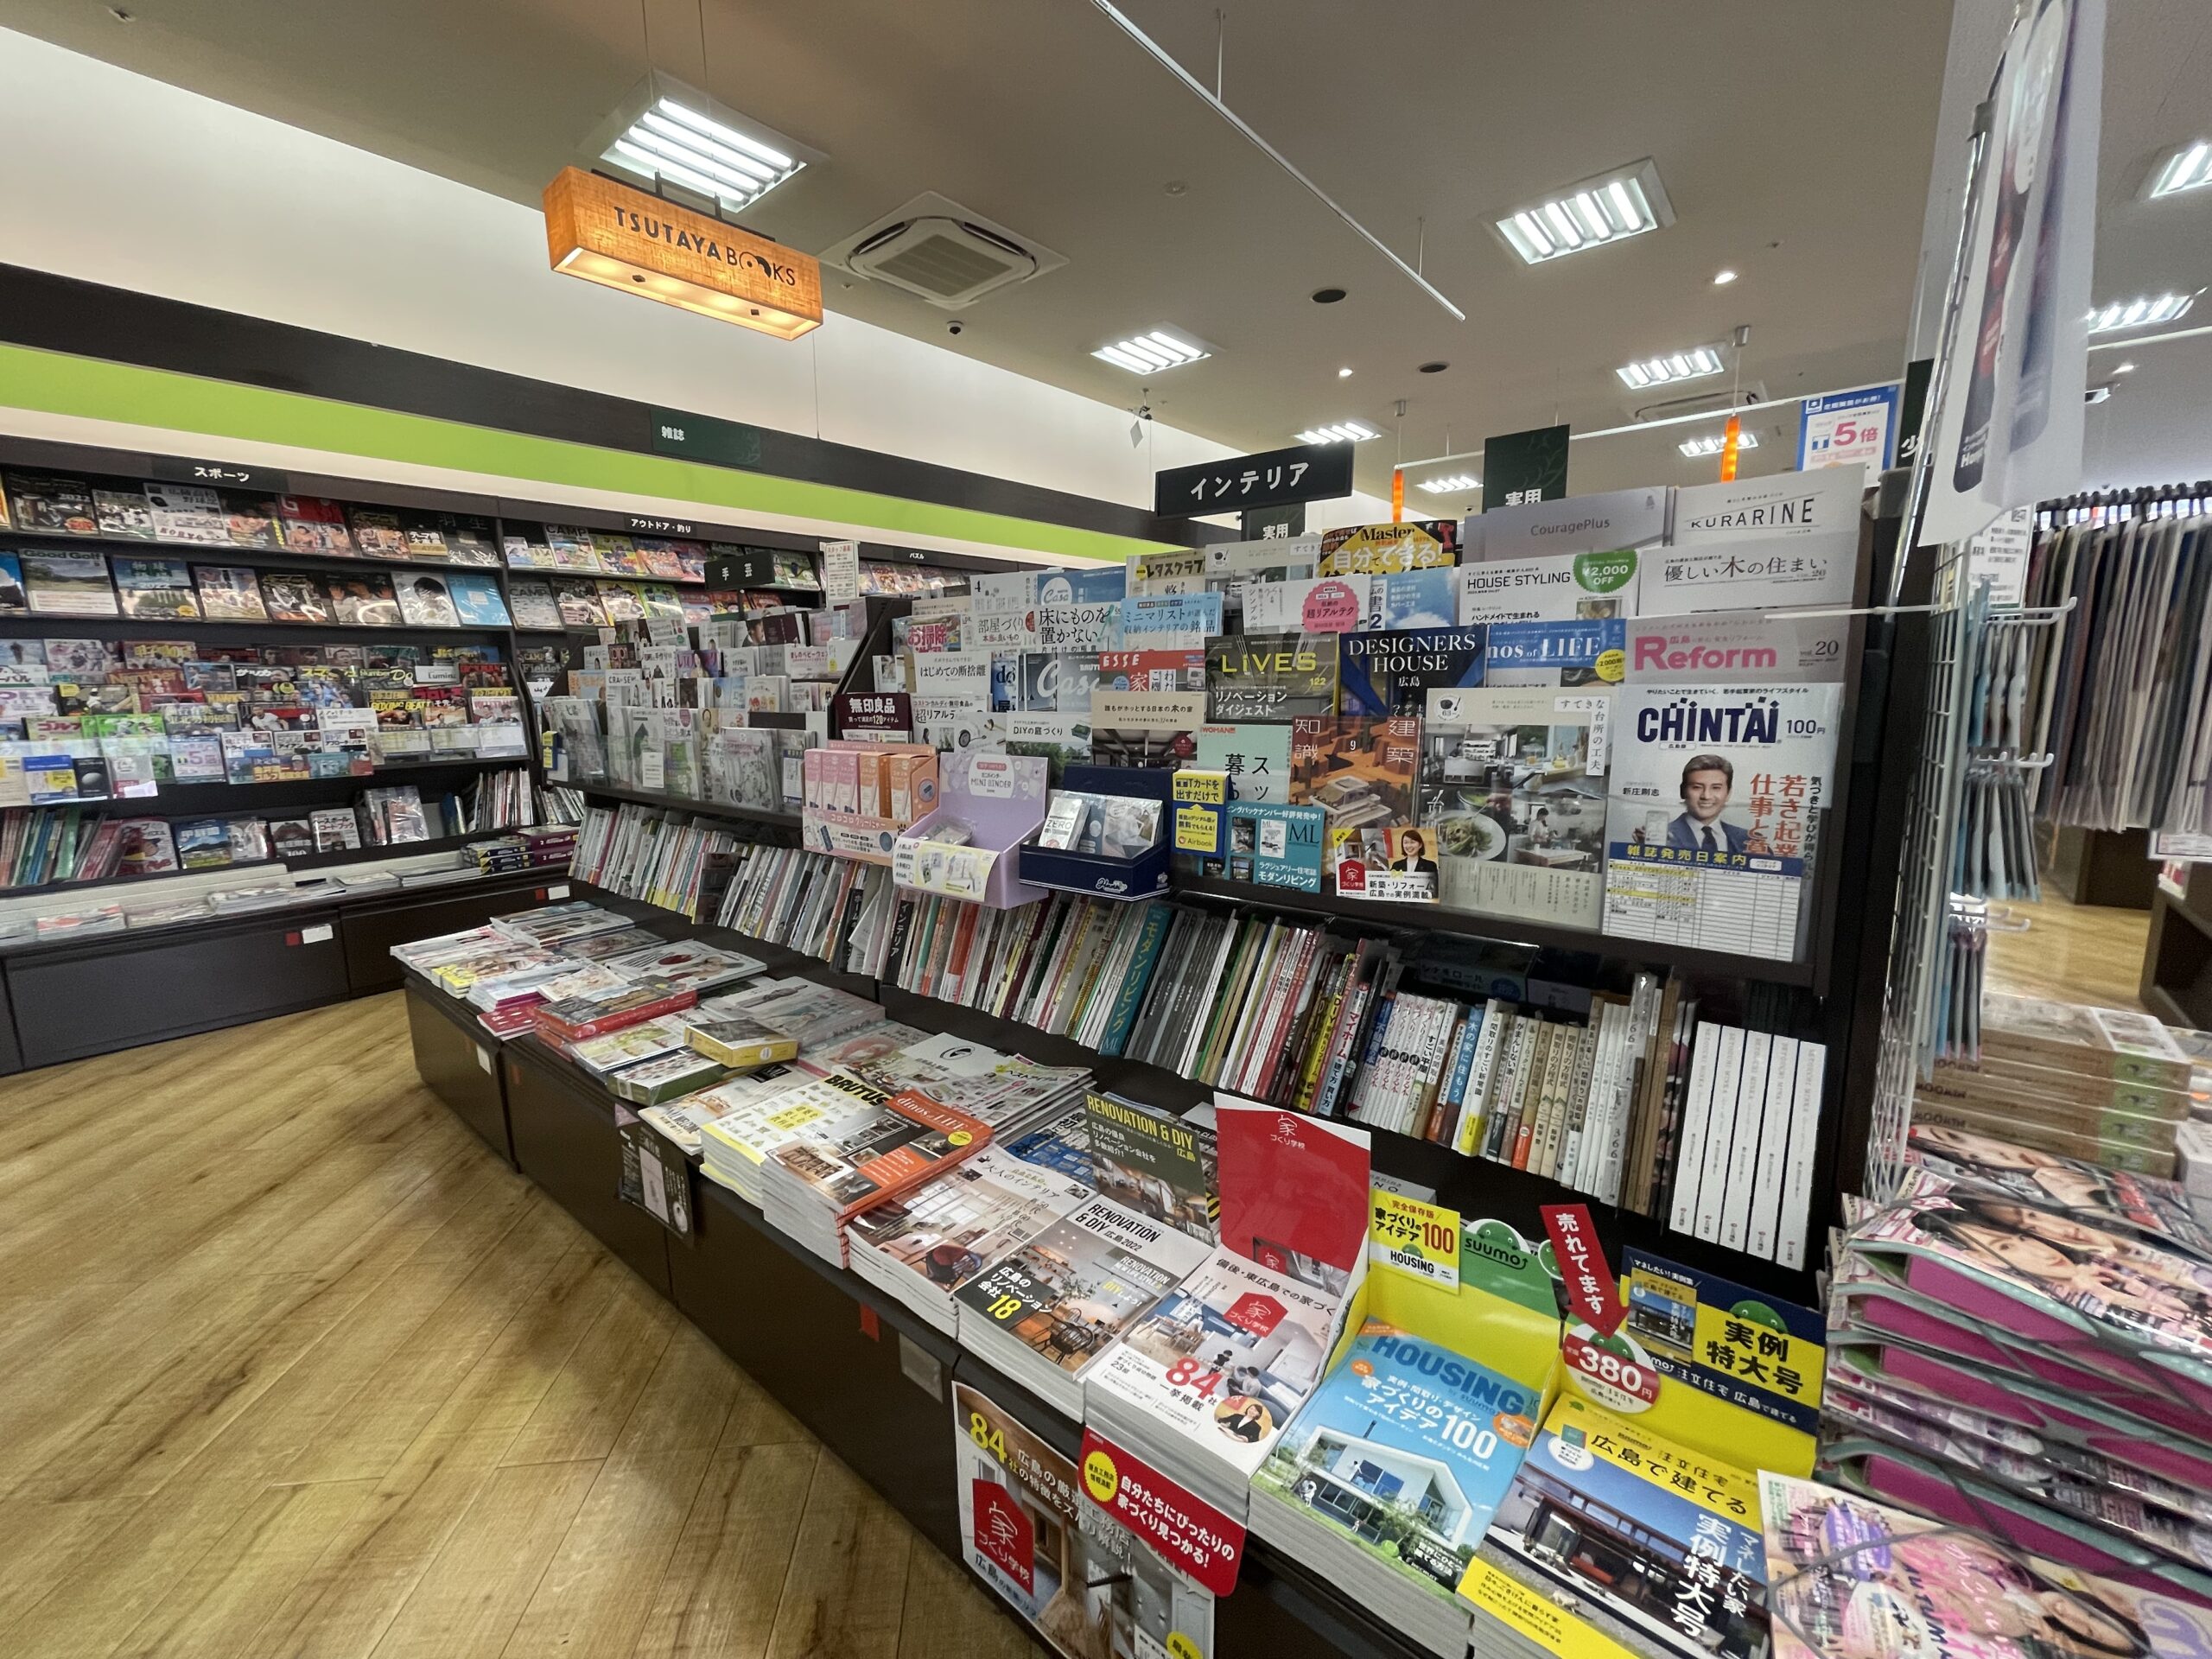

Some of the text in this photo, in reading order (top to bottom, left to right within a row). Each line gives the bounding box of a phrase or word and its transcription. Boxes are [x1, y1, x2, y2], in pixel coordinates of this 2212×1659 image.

[614, 207, 796, 287] TSUTAYA BOOKS
[661, 426, 684, 442] 雑誌
[1834, 422, 1878, 446] 5倍
[194, 467, 250, 482] スポーツ
[1190, 461, 1309, 500] インテリア
[1504, 489, 1542, 507] 実用
[631, 518, 691, 533] アウトドア・釣り
[1691, 499, 1814, 529] KURARINE
[1262, 523, 1288, 540] 実用
[1362, 526, 1415, 542] Master
[1530, 518, 1611, 537] CouragePlus
[721, 562, 753, 581] 手芸
[1467, 575, 1511, 590] HOUSE
[1515, 571, 1571, 588] STYLING
[1593, 574, 1614, 586] OFF
[908, 625, 947, 645] お掃除
[978, 619, 1024, 633] 部屋づくり
[1040, 627, 1097, 645] 置かない
[1349, 632, 1476, 656] DESIGNERS
[1541, 636, 1602, 658] LIFE
[1635, 636, 1777, 671] Reform
[1815, 640, 1839, 657] 20
[920, 664, 987, 677] はじめての断捨離
[1103, 654, 1140, 667] ESSE
[1373, 653, 1449, 673] HOUSE
[1398, 677, 1421, 688] 広島
[849, 696, 896, 715] 無印良品
[1216, 690, 1287, 703] リノベーション
[1216, 704, 1274, 716] ダイジェスト
[1637, 696, 1781, 744] CHINTAI
[1786, 719, 1826, 735] 100円
[1294, 719, 1321, 760] 知識
[1350, 740, 1357, 751] 9
[1387, 719, 1416, 764] 建築
[1287, 823, 1321, 844] ML
[1626, 843, 1747, 867] 雑誌発売日案内
[1258, 871, 1318, 887] モダンリビング
[890, 903, 907, 958] インテリア
[1112, 922, 1158, 1034] モダンリビング
[824, 1074, 893, 1107] BRUTUS
[1087, 1094, 1157, 1136] RENOVATION
[1160, 1124, 1169, 1140] &
[1172, 1128, 1194, 1150] DIY
[1176, 1147, 1196, 1162] 広島
[1375, 1206, 1421, 1230] 家づくりの
[1392, 1199, 1435, 1219] 完全保存版
[1075, 1213, 1087, 1224] &
[1085, 1216, 1110, 1234] DIY
[1121, 1238, 1142, 1252] 2022
[1087, 1203, 1161, 1243] RENOVATION
[1375, 1220, 1455, 1254] アイデア 100
[1121, 1255, 1171, 1286] RENOVATION
[1390, 1249, 1435, 1274] HOUSING
[1556, 1211, 1605, 1315] 売れてます
[999, 1267, 1031, 1288] 広島の
[977, 1281, 1022, 1319] 会社 18
[990, 1274, 1053, 1314] リノベーション
[1723, 1318, 1789, 1363] 実例
[1372, 1334, 1526, 1415] HOUSING
[1578, 1345, 1653, 1400] 380円
[1706, 1340, 1804, 1395] 特大号
[1166, 1357, 1224, 1407] 84 社
[1159, 1382, 1205, 1412] 一挙掲載
[1360, 1374, 1444, 1421] 家づくりの
[1365, 1391, 1440, 1431] アイデア
[1440, 1410, 1498, 1460] 100
[969, 1413, 1007, 1464] 84
[1591, 1435, 1748, 1516] 広島で建てる
[1121, 1475, 1236, 1561] 自分たちにぴったりの
[1117, 1495, 1211, 1568] 家づくり見つかる!
[1669, 1514, 1732, 1637] 実例特大号
